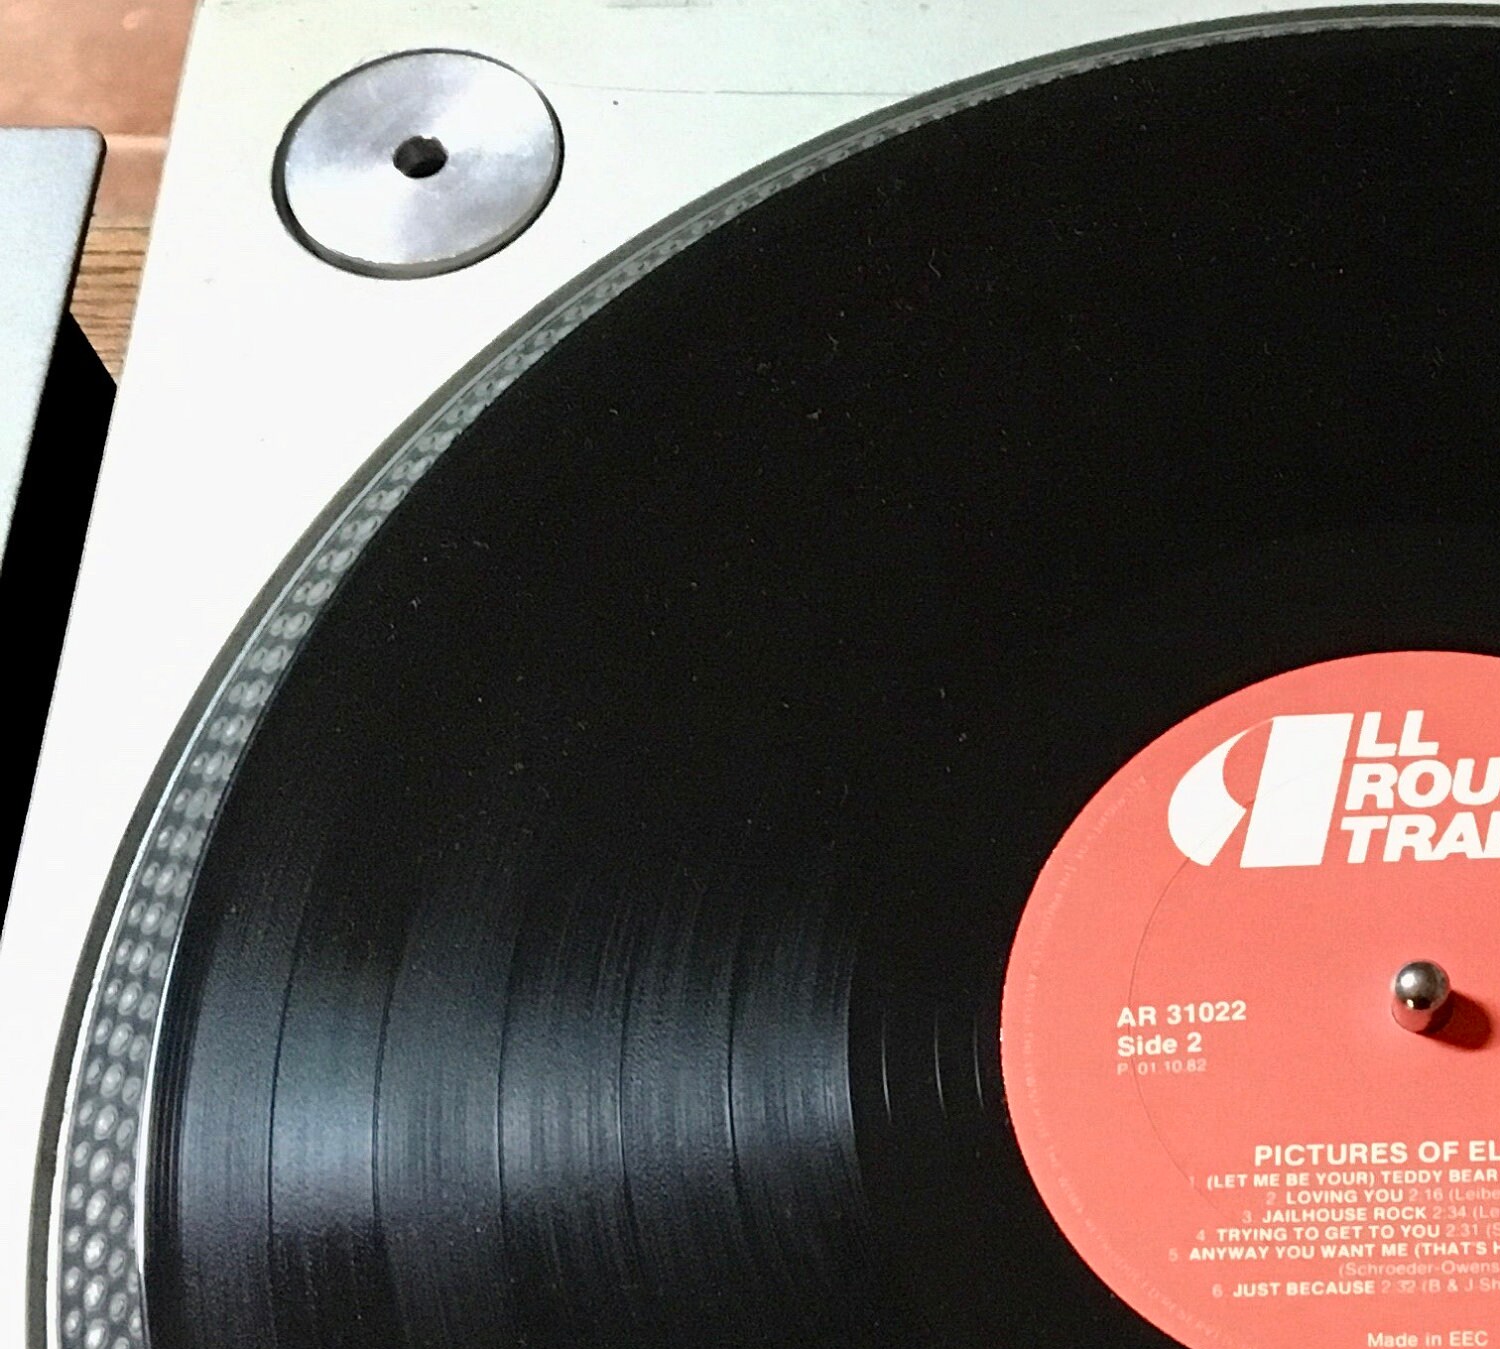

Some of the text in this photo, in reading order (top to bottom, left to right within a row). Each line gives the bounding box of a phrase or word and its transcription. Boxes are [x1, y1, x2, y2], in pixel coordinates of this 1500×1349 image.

[1116, 999, 1247, 1028] AR 31022
[1117, 1031, 1202, 1057] Side 2
[1254, 1141, 1408, 1167] PICTURES
[1417, 1140, 1459, 1164] OF
[1207, 1173, 1248, 1190] (LET
[1253, 1173, 1278, 1187] ME
[1286, 1173, 1308, 1186] BE
[1316, 1171, 1375, 1187] YOUR)
[1380, 1169, 1443, 1184] TEDDY
[1448, 1168, 1498, 1183] BEAR
[1265, 1191, 1277, 1206] 2
[1286, 1189, 1358, 1205] LOVING
[1363, 1188, 1404, 1203] YOU
[1242, 1210, 1253, 1224] 3
[1262, 1207, 1367, 1224] JAILHOUSE
[1373, 1206, 1426, 1221] ROCK
[1196, 1229, 1206, 1242] 4
[1217, 1227, 1288, 1242] TRYING
[1293, 1226, 1320, 1241] TO
[1324, 1225, 1363, 1241] GET
[1368, 1224, 1395, 1239] TO
[1400, 1224, 1440, 1239] YOU
[1189, 1246, 1269, 1261] ANYWAY
[1275, 1245, 1315, 1259] YOU
[1320, 1243, 1375, 1258] WANT
[1381, 1243, 1407, 1256] ME
[1414, 1241, 1488, 1259] (THAT'S
[1212, 1284, 1223, 1298] 6
[1233, 1282, 1281, 1298] JUST
[1286, 1280, 1374, 1296] BECAUSE
[1421, 1278, 1441, 1293] (B
[1447, 1278, 1458, 1292] &
[1367, 1330, 1488, 1348] Made in EEC
